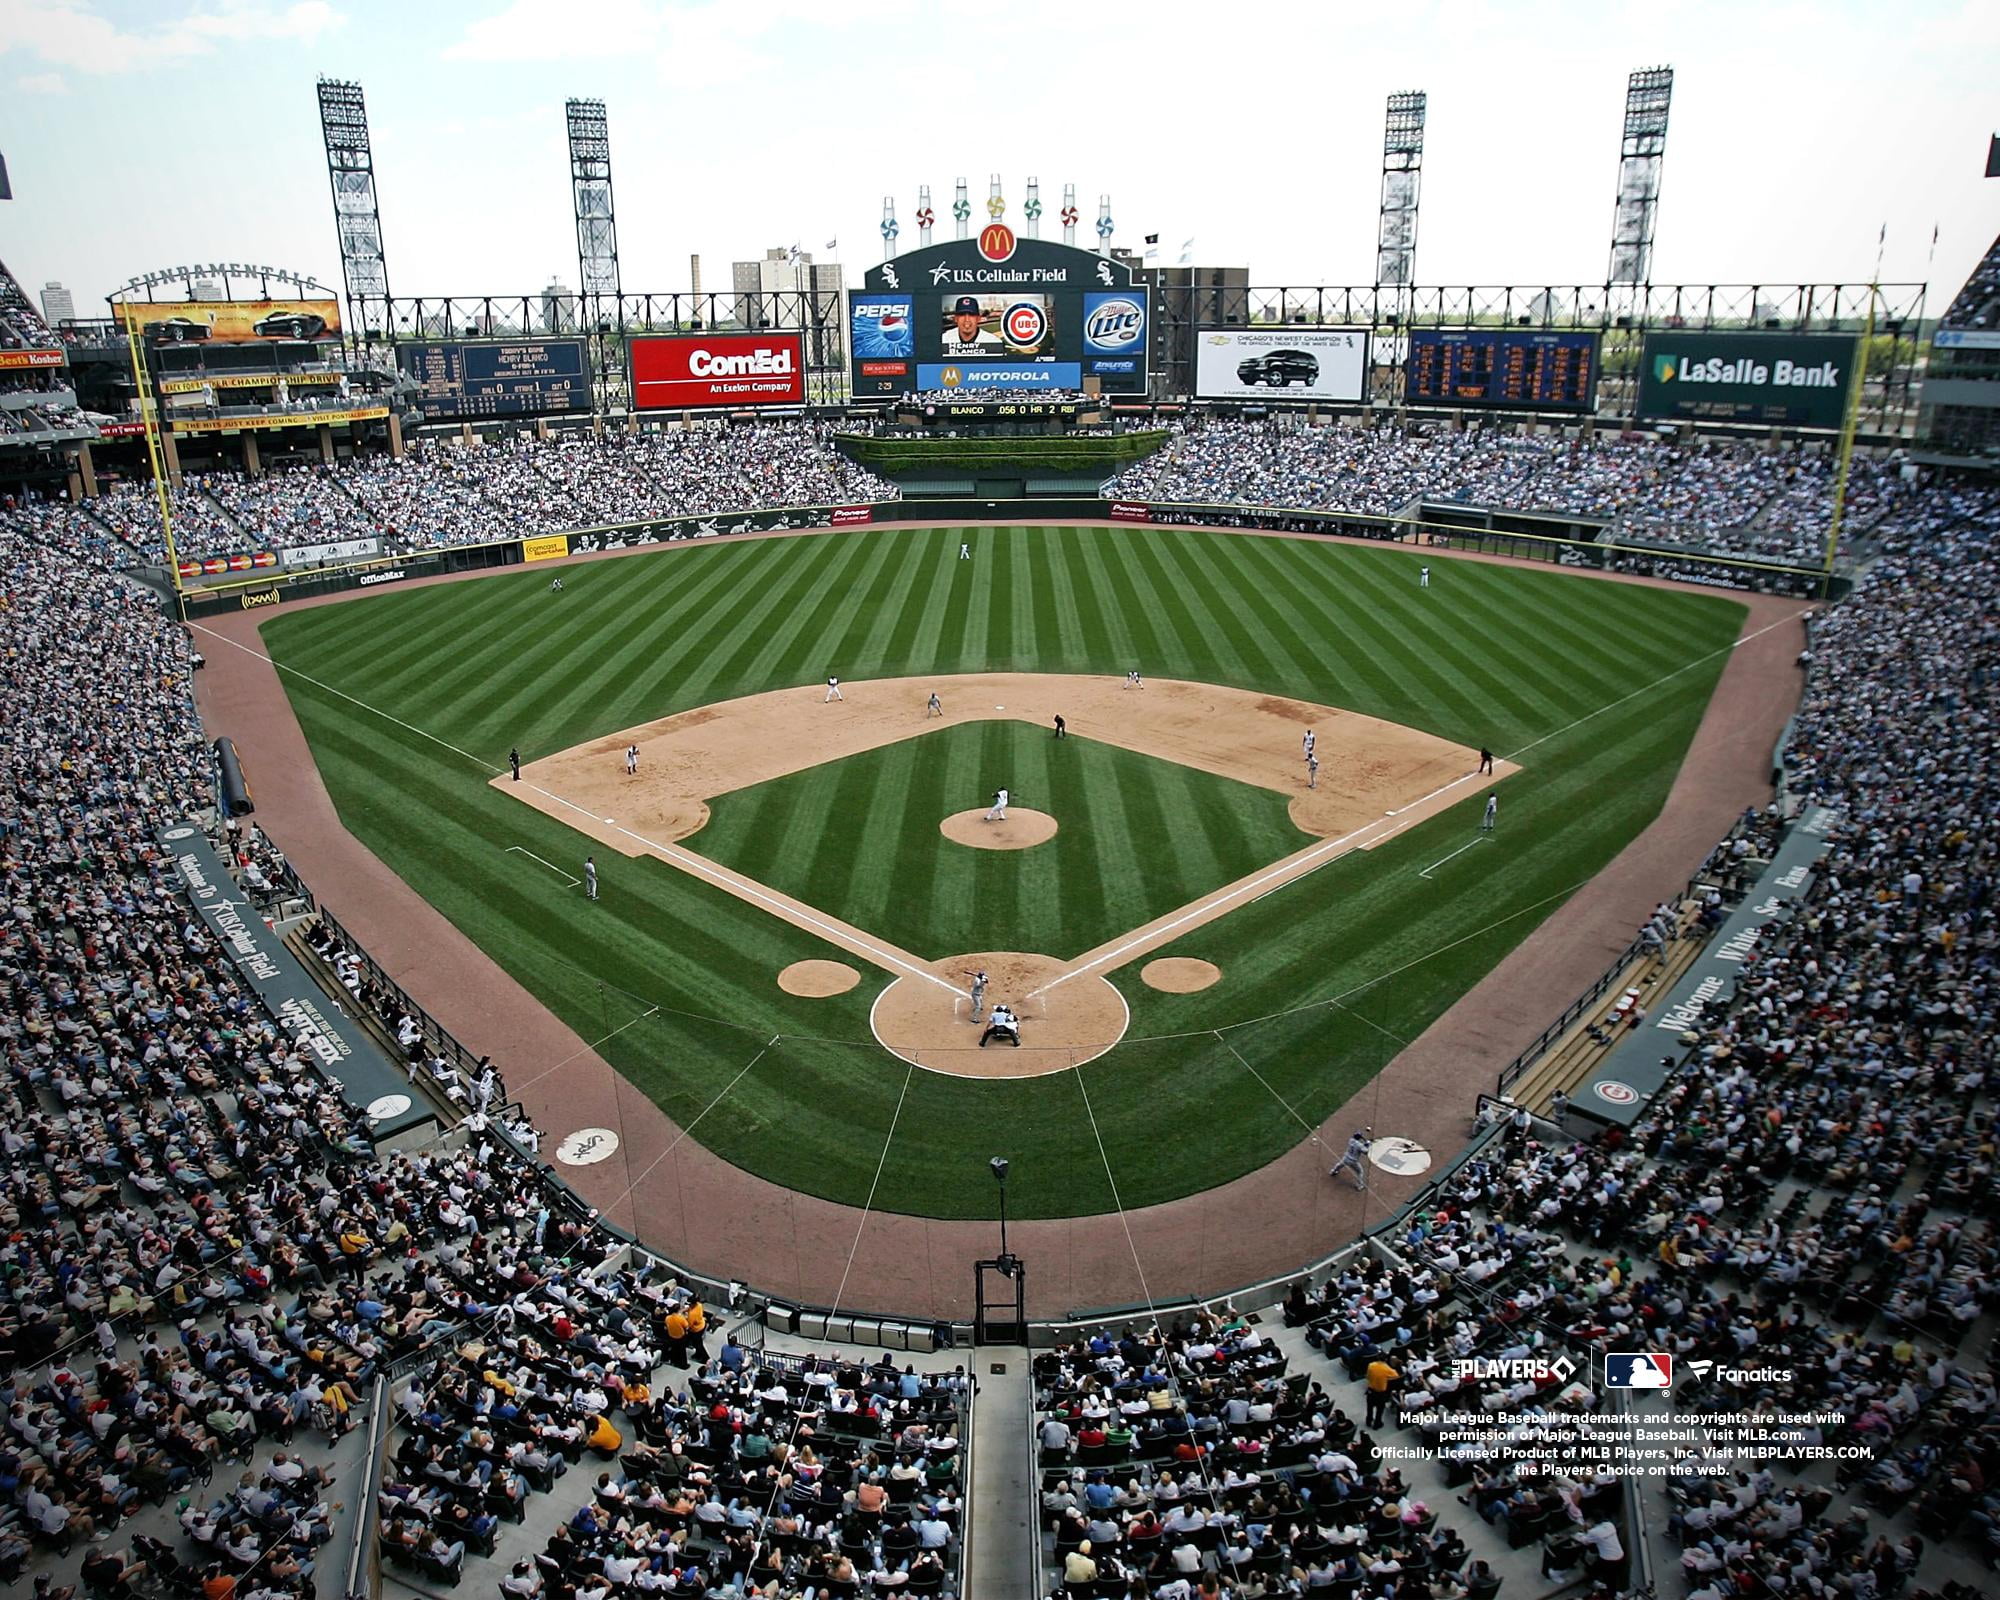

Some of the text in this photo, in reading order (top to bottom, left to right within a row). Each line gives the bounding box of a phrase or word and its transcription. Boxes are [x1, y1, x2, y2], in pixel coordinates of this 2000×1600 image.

[128, 263, 317, 293] FUNDAMENTALS
[976, 269, 1031, 282] Cellular
[1032, 268, 1067, 281] Field
[854, 304, 909, 318] PEPSI
[1092, 313, 1139, 338] Lite
[29, 354, 63, 364] Kosher
[498, 353, 548, 363] HENRY BLANCO
[968, 372, 1049, 381] MOTOROLA
[1678, 357, 1839, 387] LaSalle Bank
[497, 384, 503, 393] 0
[564, 380, 570, 390] 0
[724, 384, 750, 392] Exelon
[752, 382, 791, 392] Company
[997, 405, 1016, 414] .056
[1030, 404, 1043, 413] HR
[834, 509, 870, 517] Pioneer
[360, 571, 405, 585] OfficeMax
[178, 853, 207, 888] Welcome
[197, 884, 218, 899] To
[1715, 927, 1762, 961] White
[249, 952, 280, 980] Field
[1656, 975, 1725, 1033] Welcome
[309, 1035, 345, 1066] SOX
